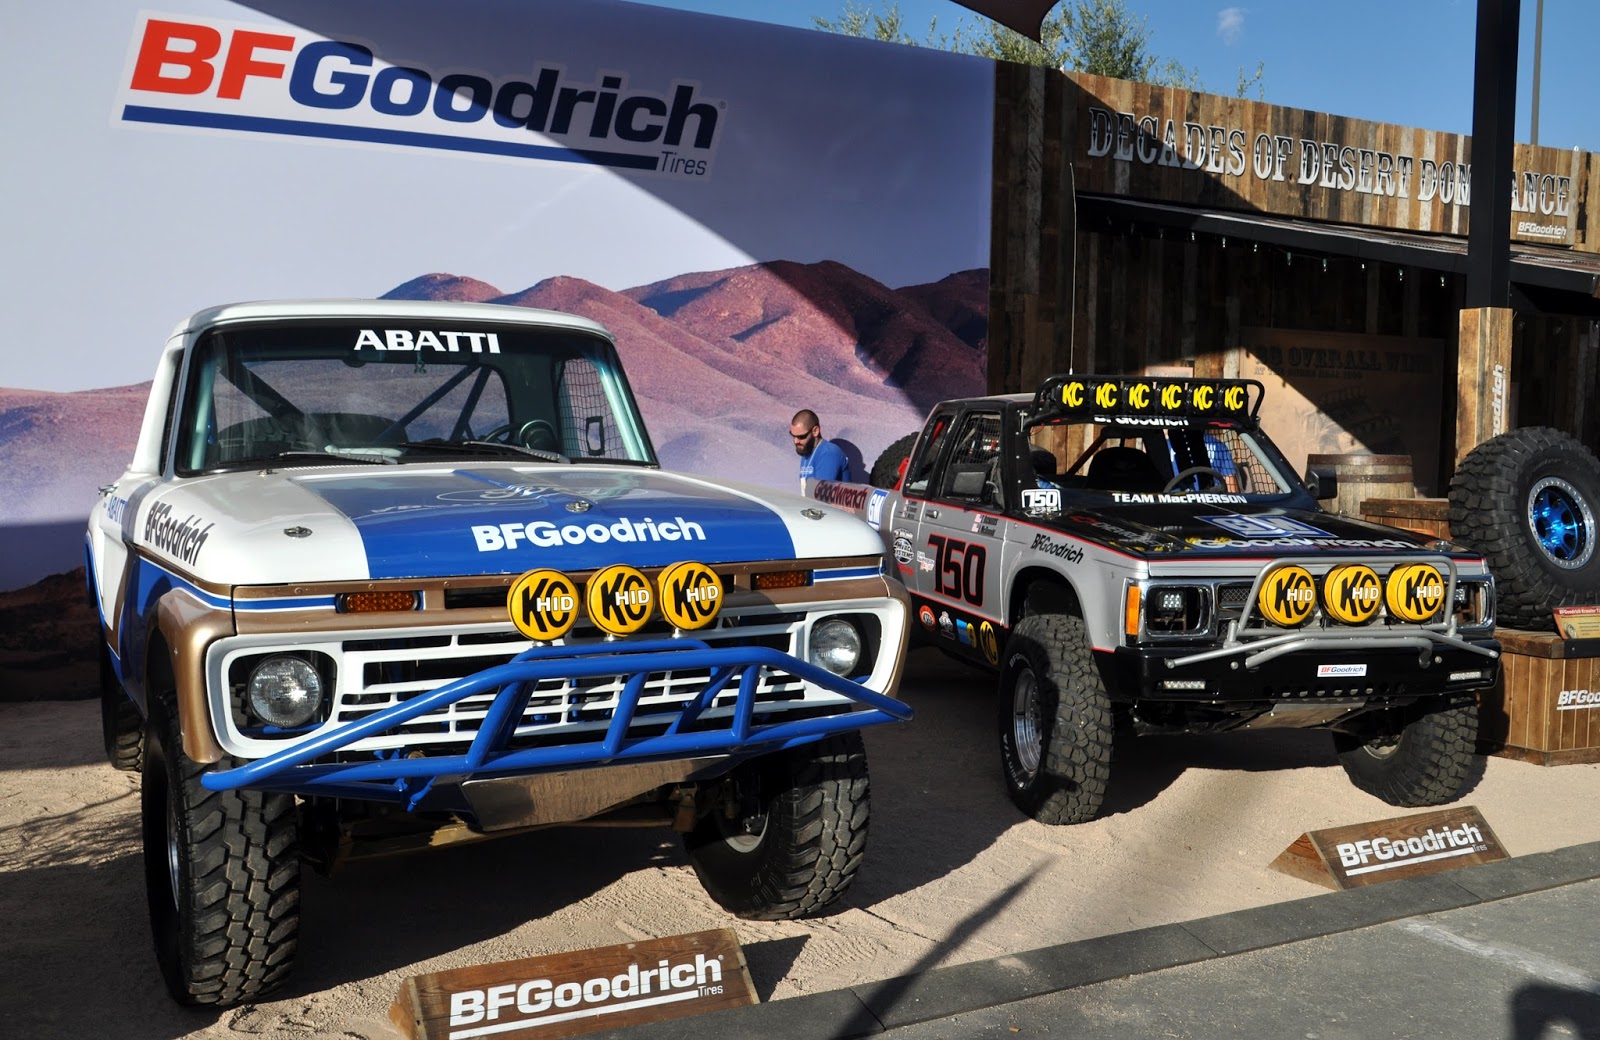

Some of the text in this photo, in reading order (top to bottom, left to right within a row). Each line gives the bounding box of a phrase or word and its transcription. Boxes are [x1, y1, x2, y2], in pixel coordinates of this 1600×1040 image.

[130, 19, 719, 149] BFGoodrich
[660, 150, 707, 176] Tires
[1088, 107, 1571, 217] DECADES OF DESERT DOMANCE
[1518, 222, 1567, 236] BFGoodrich
[354, 329, 501, 354] ABATTI
[1062, 381, 1084, 407] KC
[1096, 383, 1117, 408] KC
[1129, 383, 1150, 409] KC
[1161, 384, 1182, 410] KC
[1193, 385, 1214, 410] KC
[1224, 386, 1245, 411] KC
[1491, 364, 1504, 438] oodrich
[814, 480, 868, 510] Goodwrench
[1024, 491, 1058, 507] 750
[1112, 493, 1247, 504] TEAM MacPHERSON
[144, 500, 215, 567] BFGoodrich
[471, 517, 706, 552] BFGoodrich
[1030, 533, 1085, 564] BFGoodrich
[927, 533, 987, 608] 750
[536, 596, 574, 612] HID
[600, 573, 648, 626] KC
[615, 589, 650, 606] HID
[672, 570, 715, 621] KC
[686, 586, 719, 602] HID
[1275, 573, 1311, 618] KC
[1287, 588, 1314, 601] HID
[1340, 571, 1376, 616] KC
[1352, 586, 1379, 600] HID
[1405, 570, 1439, 615] KC
[1416, 585, 1442, 598] HID
[522, 578, 570, 632] KC
[1336, 822, 1483, 868] BFGoodrich
[450, 954, 722, 1027] BFGoodrich
[697, 984, 723, 997] Tires
